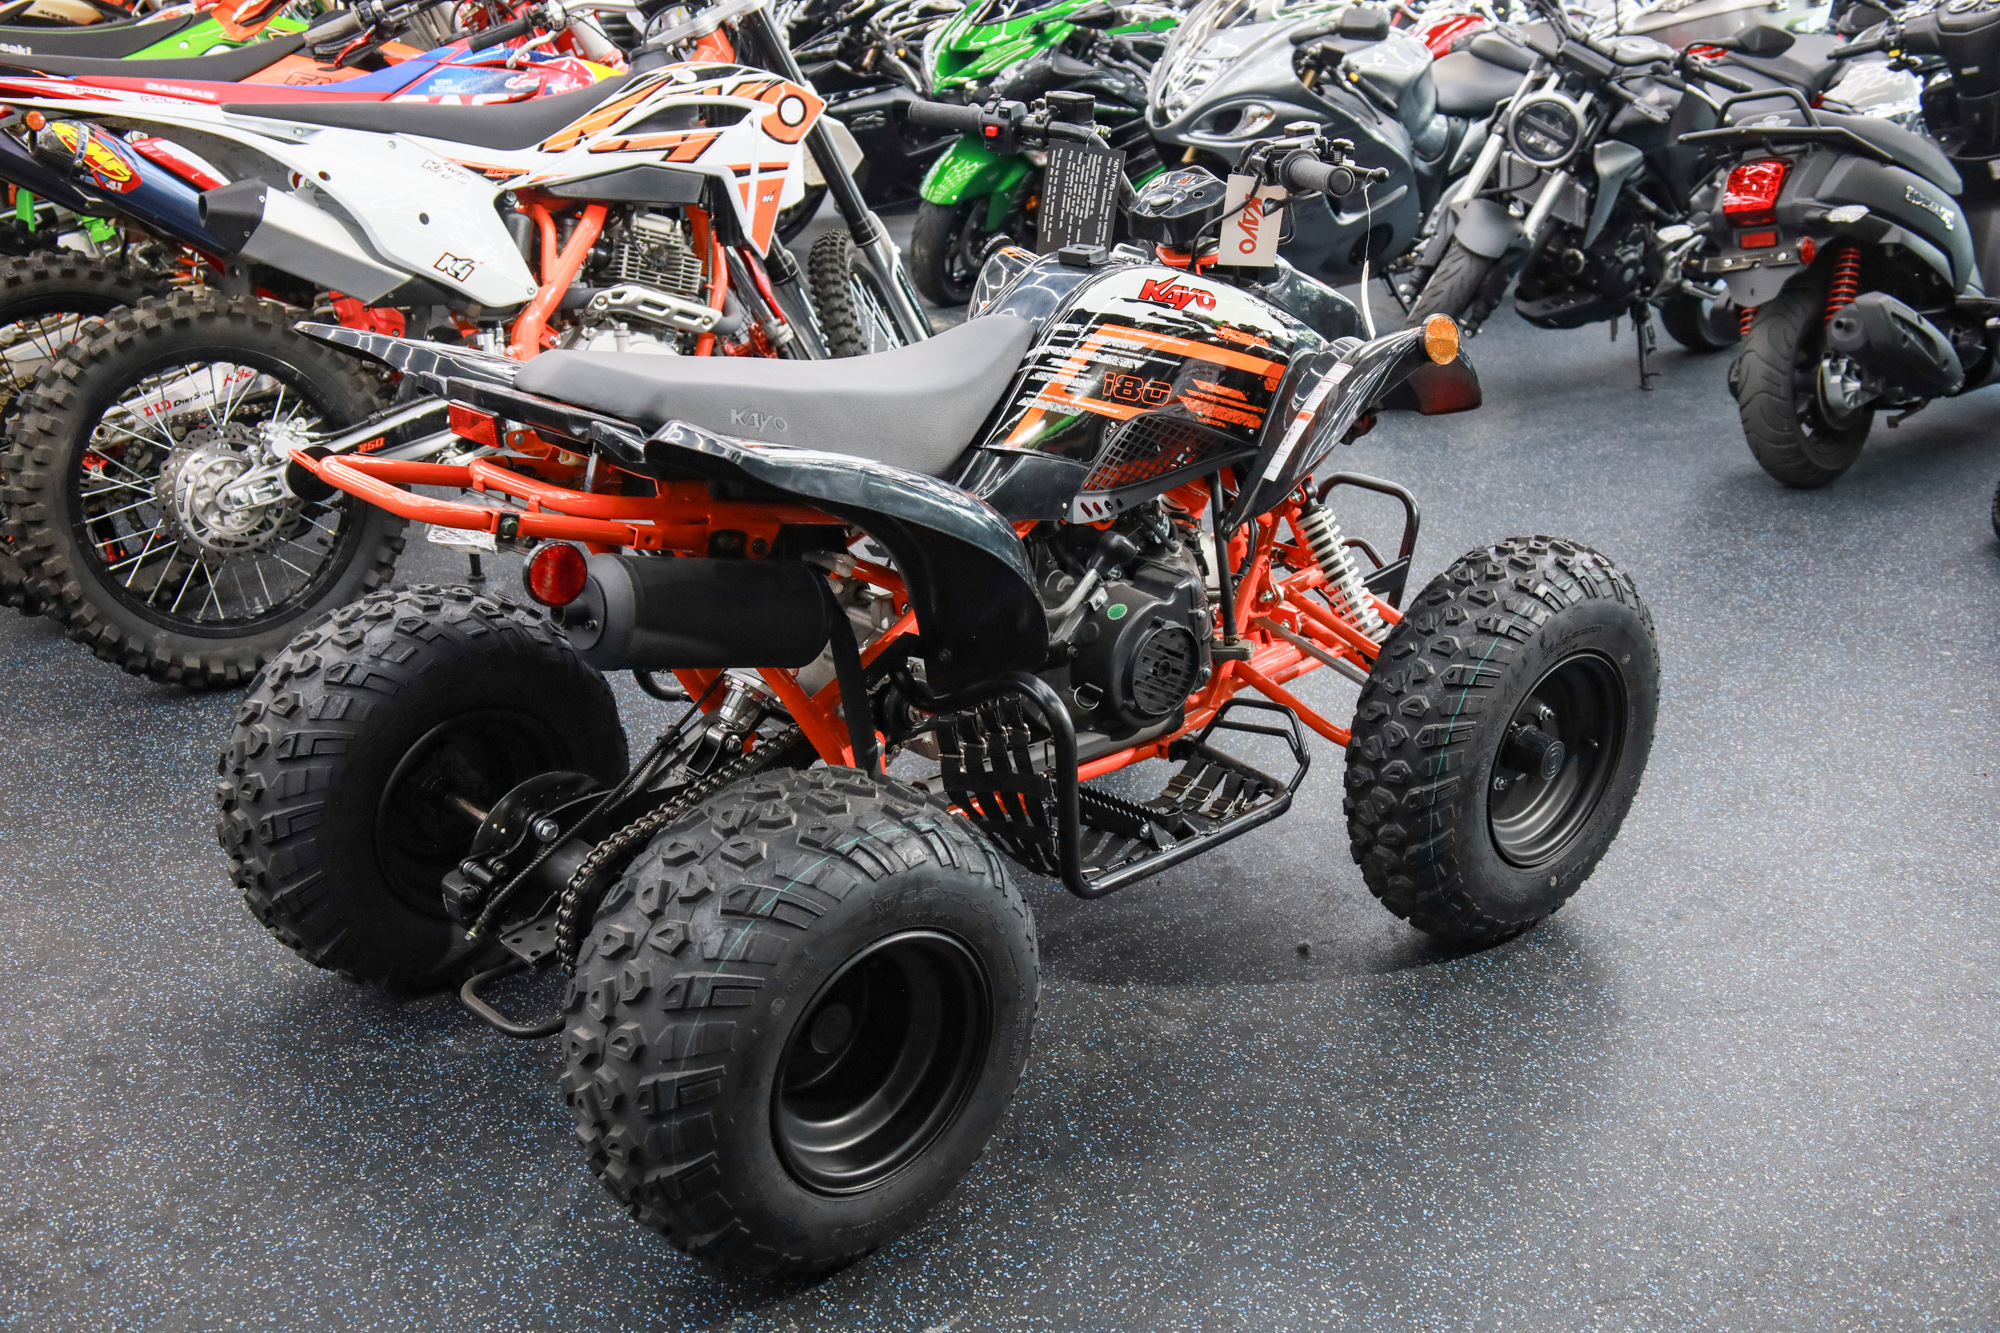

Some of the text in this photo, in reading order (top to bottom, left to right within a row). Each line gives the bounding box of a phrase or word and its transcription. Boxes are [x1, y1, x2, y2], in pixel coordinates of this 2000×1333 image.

[145, 82, 215, 101] GASGAS
[1237, 193, 1266, 254] KAYO
[1138, 275, 1217, 311] KAYO
[143, 399, 172, 417] DID
[730, 405, 789, 433] KAYO
